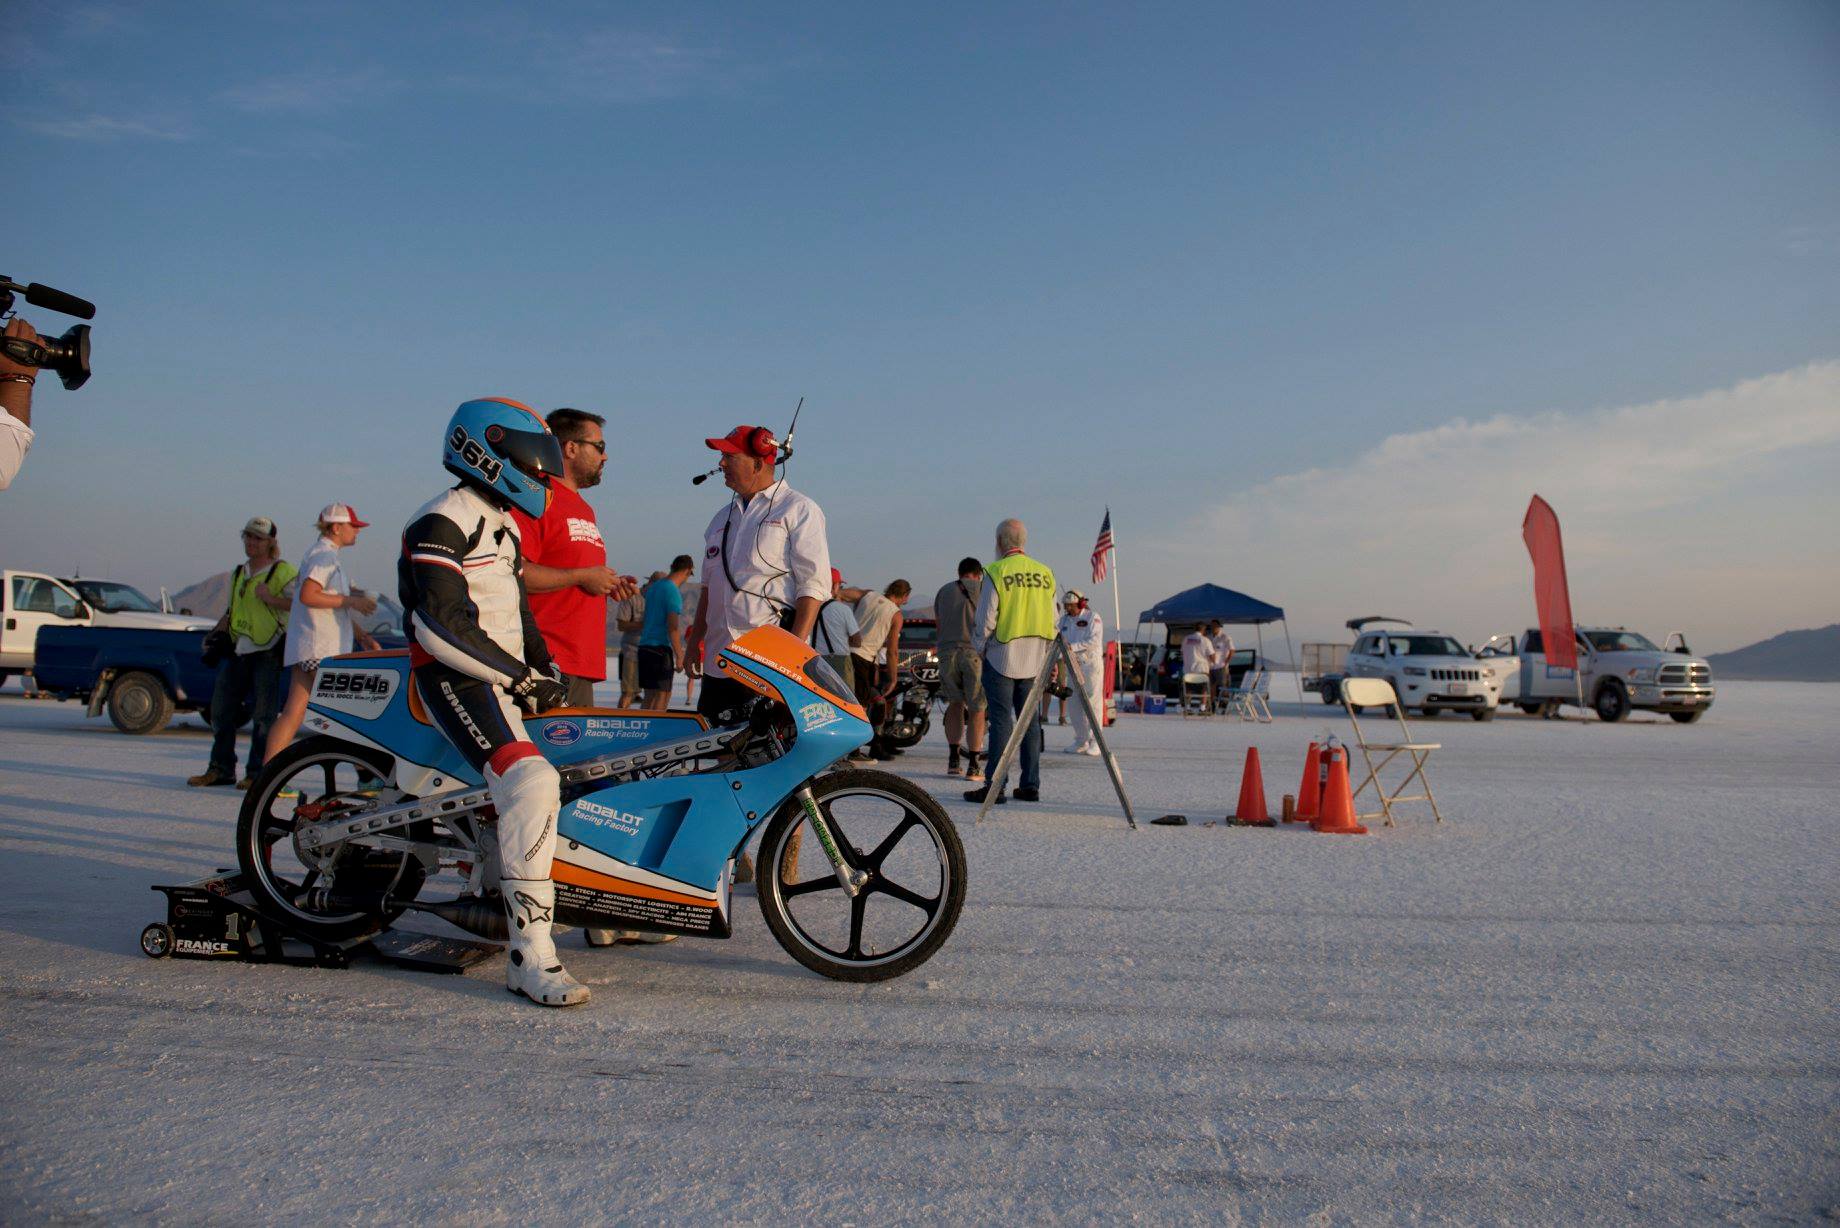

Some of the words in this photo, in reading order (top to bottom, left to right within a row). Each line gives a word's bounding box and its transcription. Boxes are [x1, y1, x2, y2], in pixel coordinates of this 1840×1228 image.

[1003, 572, 1050, 591] PRESS
[585, 729, 614, 739] Racing
[615, 730, 649, 739] Factory
[572, 809, 604, 827] Racing
[604, 818, 640, 836] Factory
[602, 893, 647, 906] MOTORSPORT
[647, 900, 680, 911] LOGISTICS
[225, 912, 240, 940] 1
[176, 939, 228, 952] FRANCE
